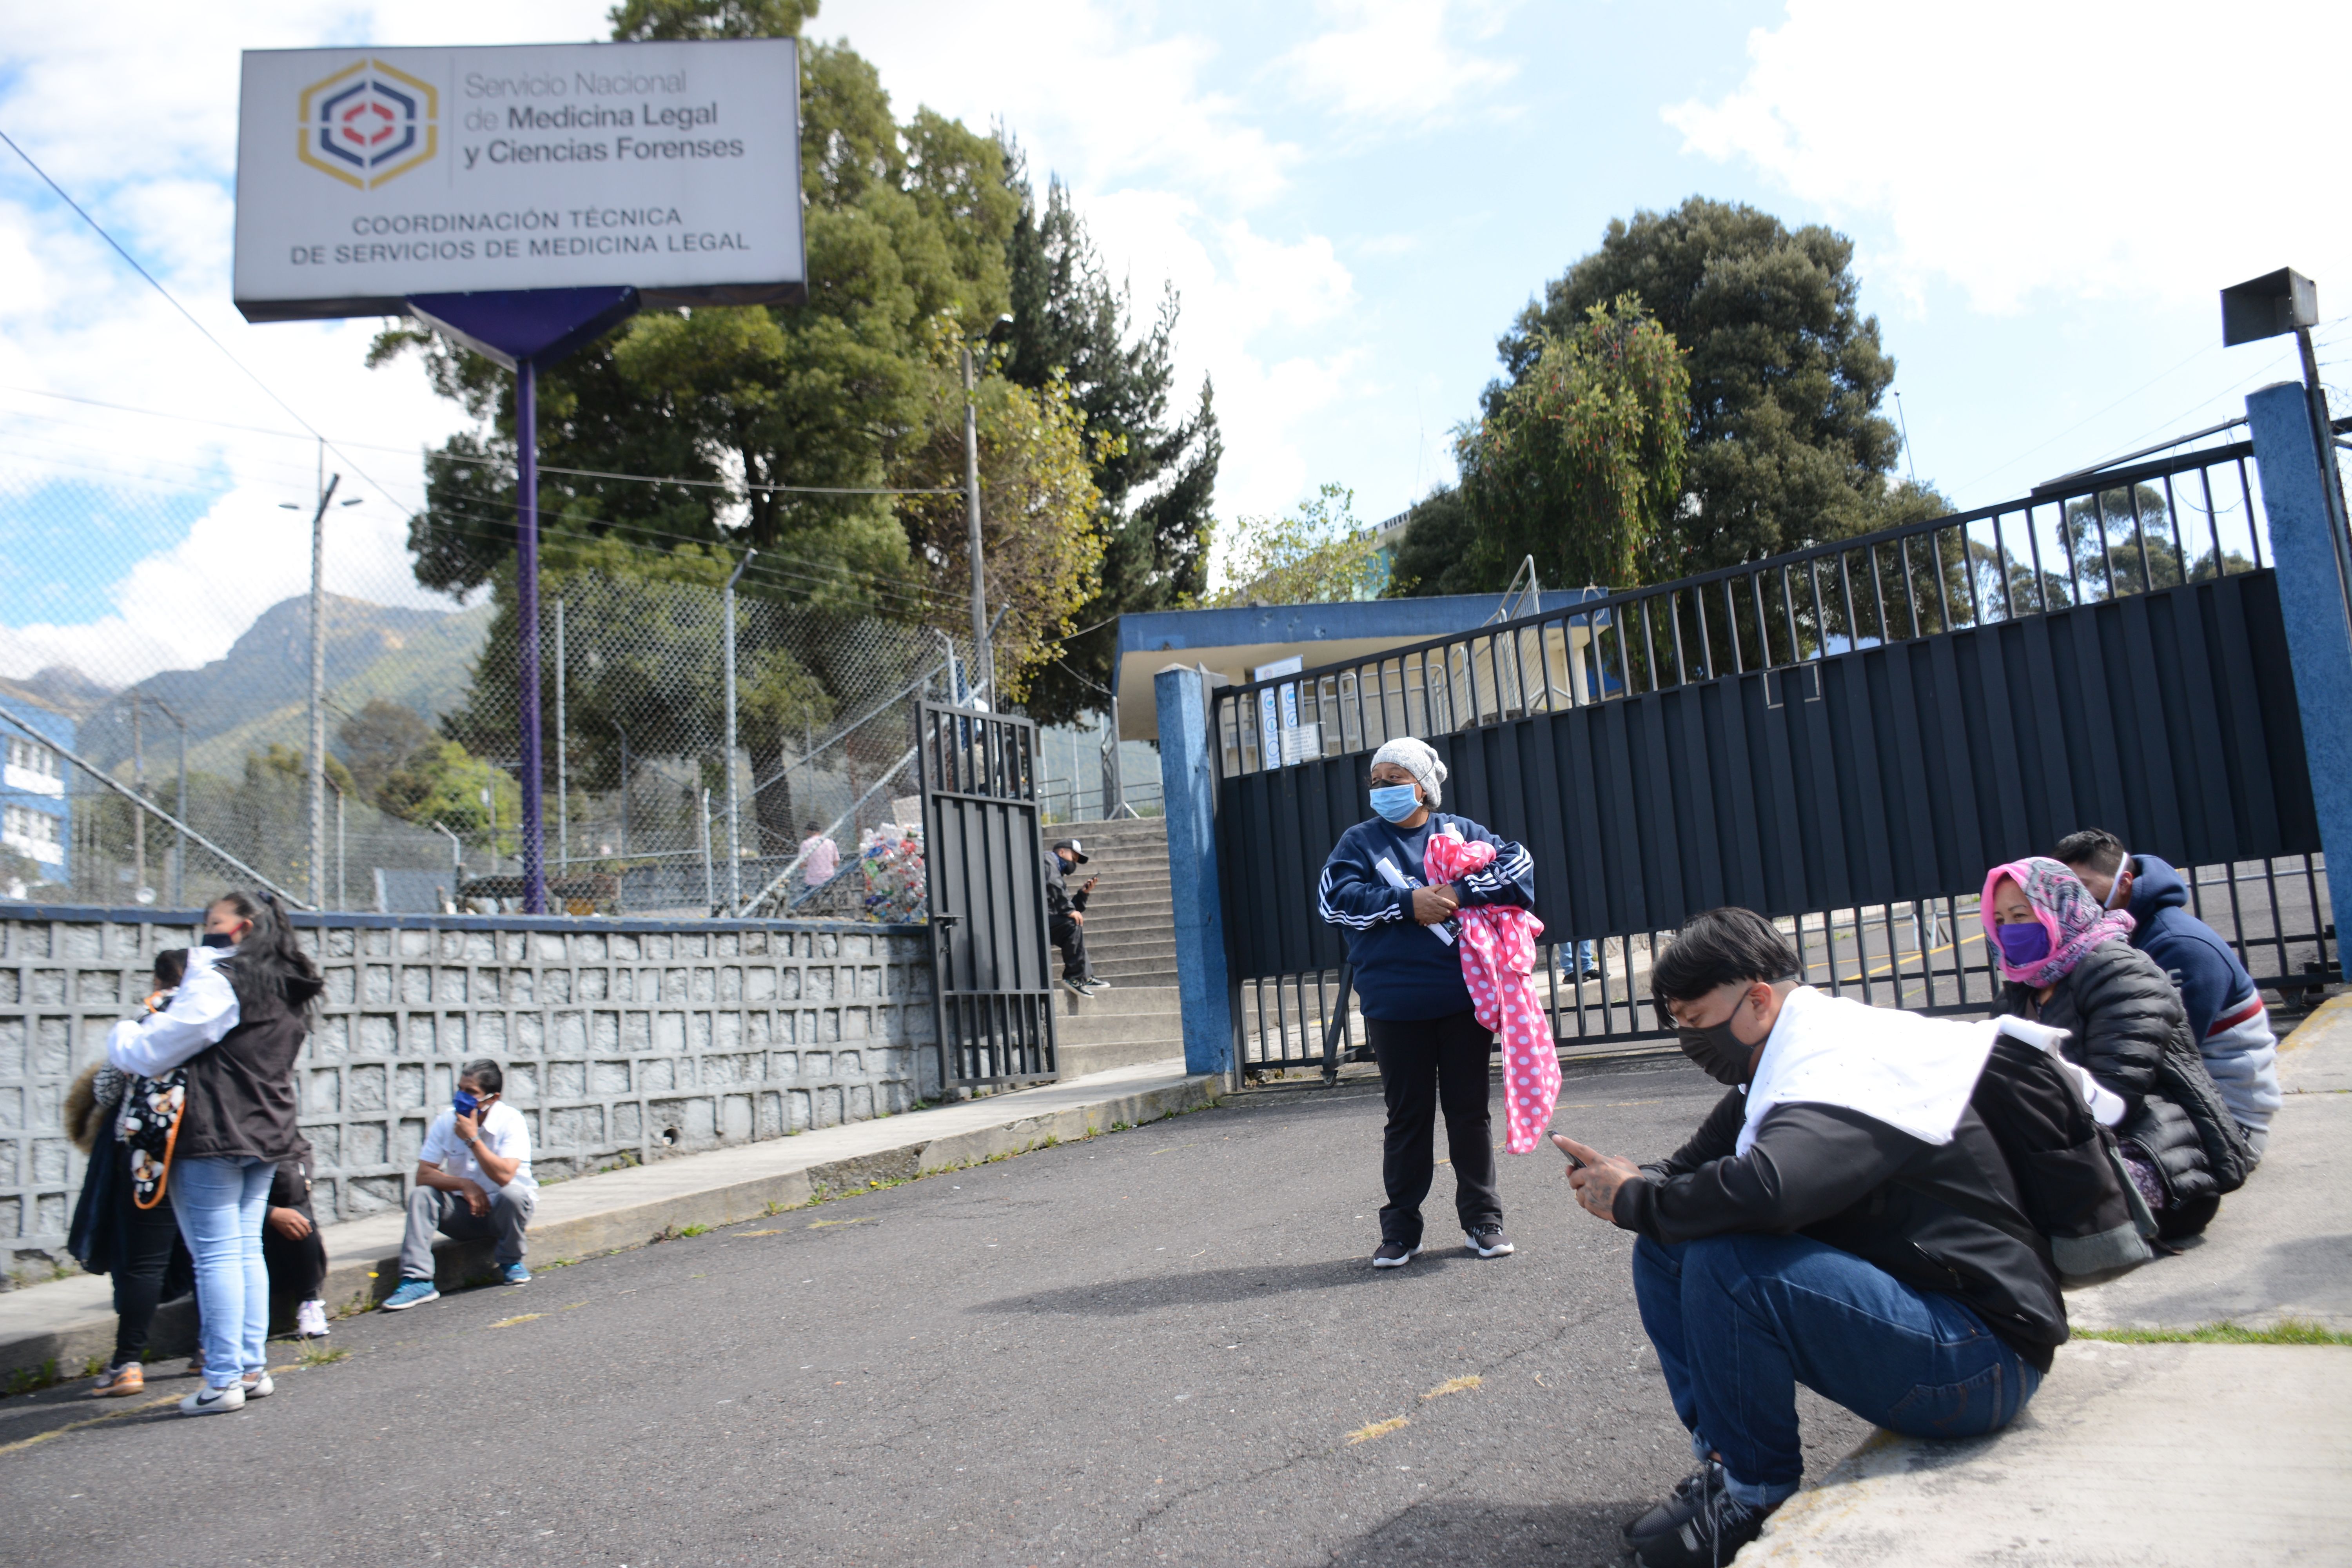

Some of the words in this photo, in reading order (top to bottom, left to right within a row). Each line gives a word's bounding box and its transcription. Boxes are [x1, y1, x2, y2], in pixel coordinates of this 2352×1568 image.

[464, 71, 568, 99] Servicio
[575, 69, 686, 96] Nacional
[464, 106, 499, 131] de
[508, 104, 634, 129] Medicina
[643, 100, 718, 131] Legal
[464, 146, 480, 170] y
[488, 137, 608, 164] Ciencias
[617, 136, 745, 160] Forenses
[353, 207, 559, 235] COORDINACIÓN
[568, 206, 682, 228] TÉCNICA
[290, 245, 326, 265] DE
[334, 240, 476, 264] SERVICIOS
[486, 238, 520, 259] DE
[528, 234, 659, 257] MEDICINA
[668, 232, 751, 252] LEGAL
